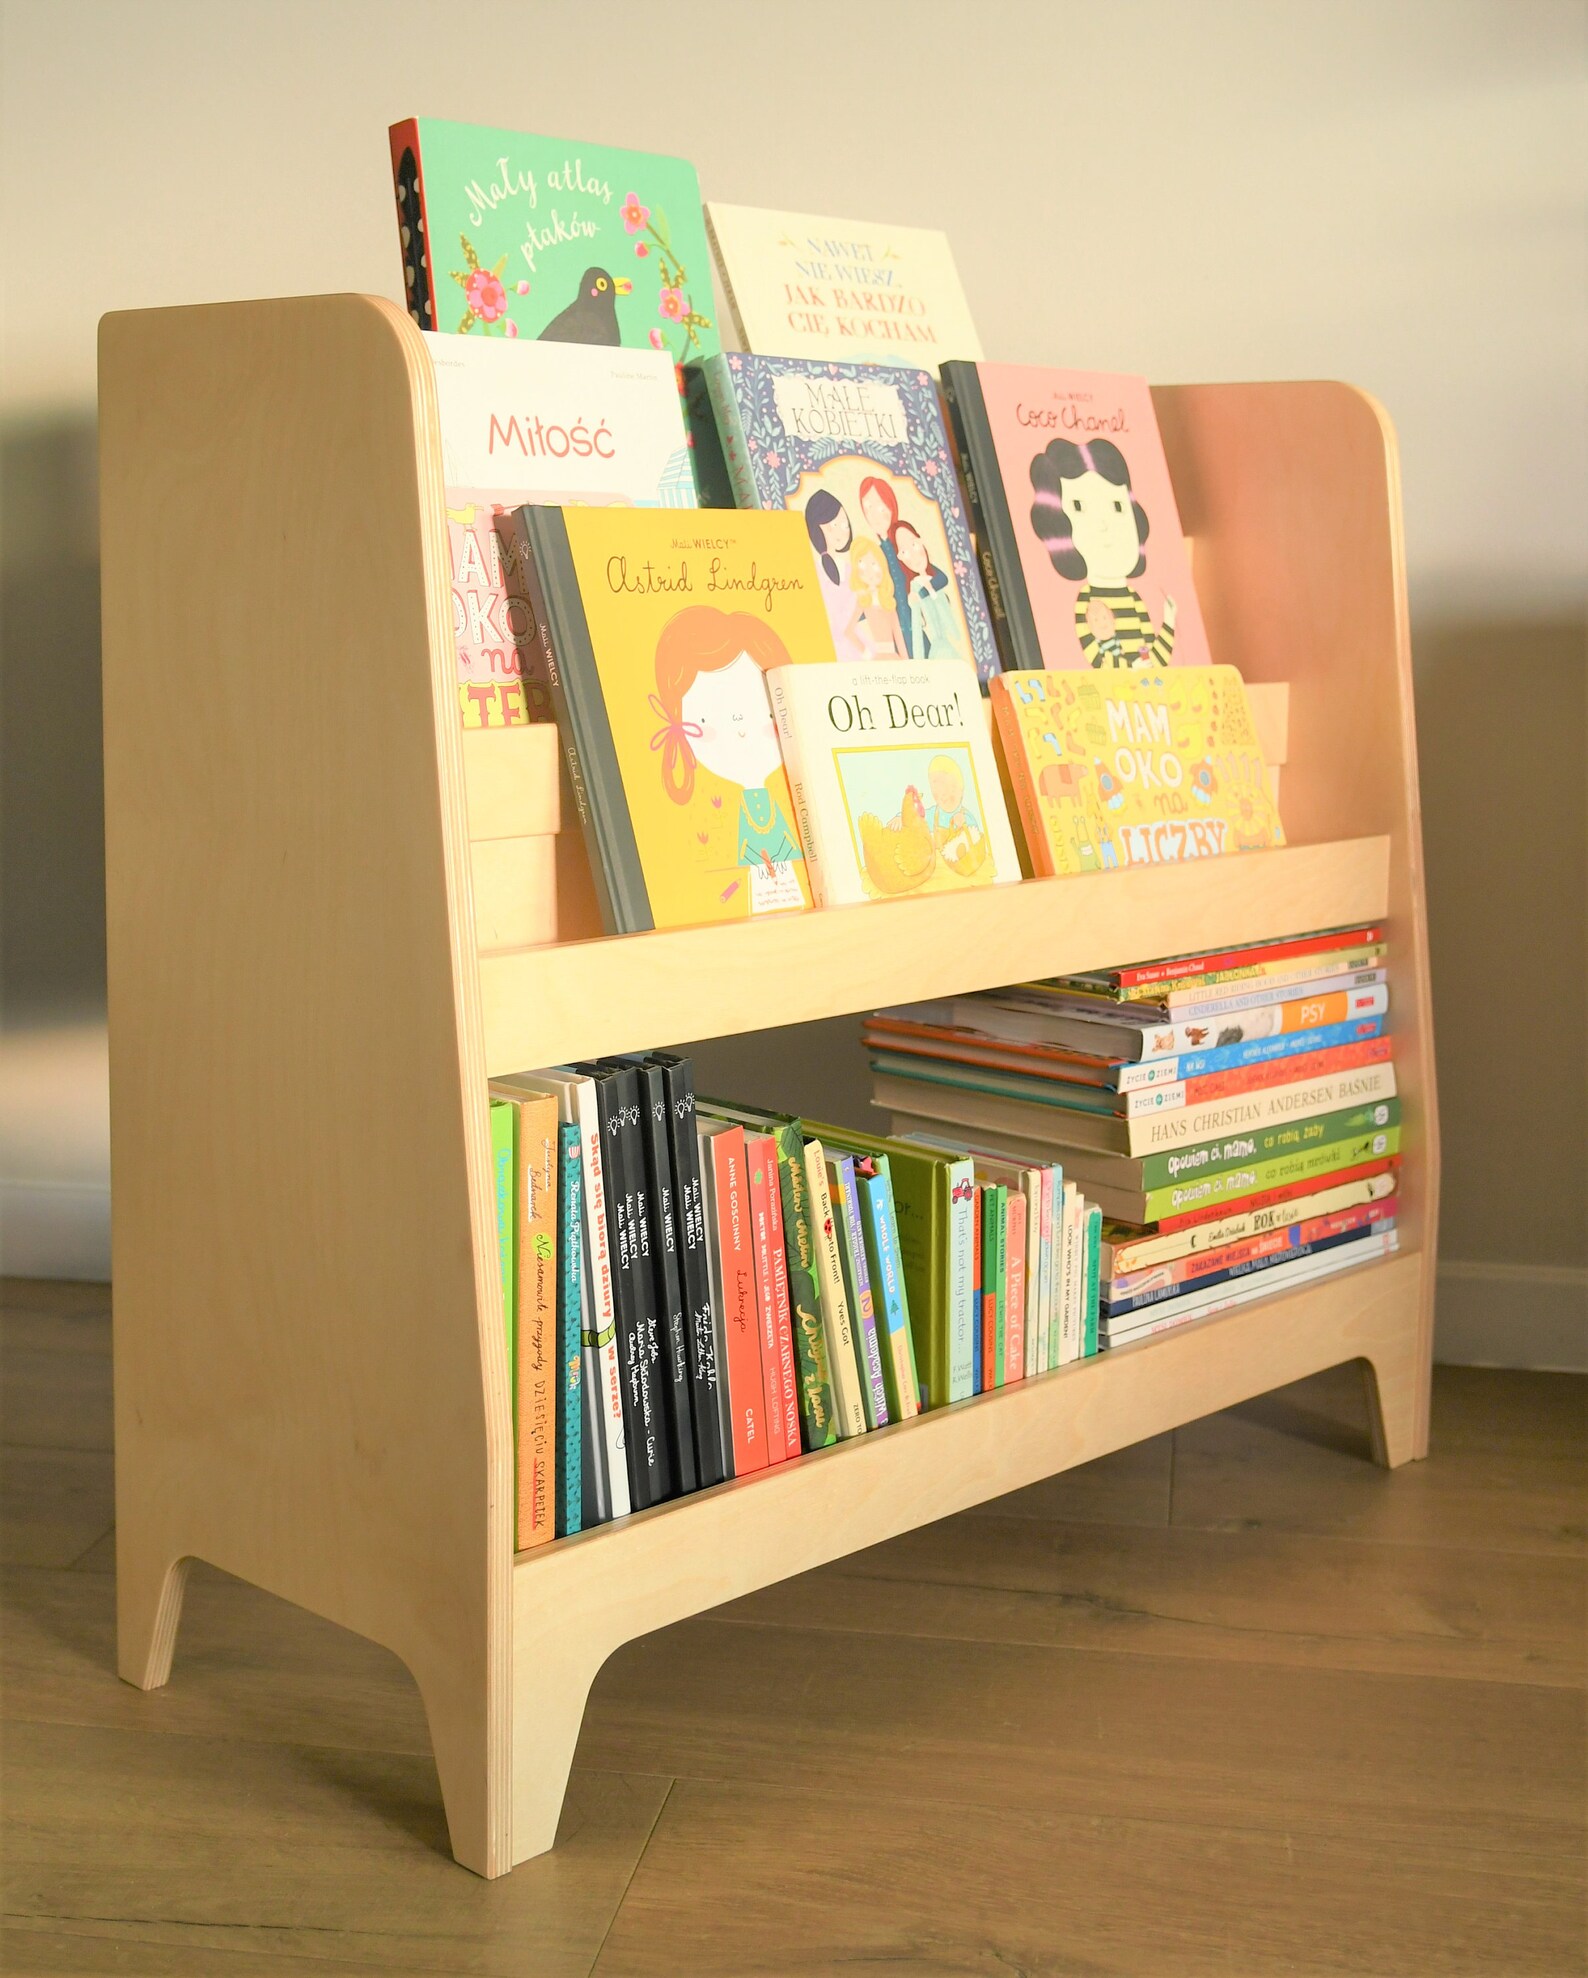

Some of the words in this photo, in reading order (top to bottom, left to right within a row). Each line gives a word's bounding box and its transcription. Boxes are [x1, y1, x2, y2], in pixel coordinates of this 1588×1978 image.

[464, 156, 538, 228] Mały
[547, 158, 614, 205] atlas
[519, 209, 602, 273] ptaków
[806, 238, 873, 262] NAWET
[795, 261, 832, 281] NIE
[784, 283, 826, 307] JAK
[832, 287, 927, 317] BARDZO
[787, 311, 830, 338] CIĘ
[835, 316, 938, 344] KOCHAM
[791, 407, 897, 439] KOBIETKI
[1015, 402, 1058, 429] Coco
[1061, 404, 1129, 432] Chanel
[488, 412, 616, 459] Miłość
[606, 555, 693, 594] Astrid
[706, 556, 804, 612] Lindgren
[545, 648, 560, 689] WIELCY
[909, 673, 931, 685] book
[773, 686, 785, 705] Oh
[827, 694, 877, 733] Oh
[882, 691, 965, 730] Dear!
[778, 707, 793, 740] Dear!
[1105, 698, 1172, 746] MAM
[1114, 746, 1183, 790] OKO
[794, 782, 807, 806] Rod
[1153, 792, 1189, 816] na
[800, 807, 819, 863] Campbell
[1119, 818, 1228, 866] LICZBY
[1300, 1002, 1327, 1025] PSY
[1151, 1119, 1188, 1143] HANS
[1193, 1102, 1261, 1133] CHRISTIAN
[1267, 1086, 1334, 1114] ANDERSEN
[1338, 1073, 1381, 1099] BAŚNIE
[590, 1132, 601, 1177] Skąd
[1264, 1137, 1274, 1148] co
[727, 1157, 737, 1188] ANNE
[813, 1149, 825, 1187] Louie's
[1265, 1169, 1276, 1179] co
[570, 1181, 581, 1219] Renata
[593, 1182, 603, 1212] się
[625, 1193, 634, 1218] Mali
[637, 1191, 645, 1216] Mali
[662, 1187, 670, 1213] Mali
[683, 1184, 692, 1209] Mali
[691, 1177, 700, 1201] Mali
[820, 1192, 831, 1218] Back
[616, 1203, 626, 1228] Mali
[663, 1212, 675, 1253] WIELCY
[685, 1208, 697, 1250] WIELCY
[693, 1200, 704, 1242] WIELCY
[730, 1190, 742, 1252] GOSCINNY
[958, 1207, 969, 1247] That's
[1254, 1210, 1276, 1232] ROK
[569, 1221, 581, 1284] Piątkowska
[594, 1213, 607, 1262] biorą
[619, 1227, 630, 1270] WIELCY
[628, 1218, 639, 1259] WIELCY
[638, 1216, 650, 1257] WIELCY
[828, 1242, 836, 1253] to
[879, 1215, 890, 1252] WHOLE
[885, 1254, 896, 1294] WORLD
[829, 1253, 841, 1284] Front!
[958, 1249, 968, 1271] not
[1011, 1256, 1022, 1268] A
[600, 1264, 613, 1318] dziury
[734, 1269, 749, 1334] Lukrecja
[955, 1271, 965, 1298] my
[1010, 1274, 1022, 1310] Piece
[1065, 1289, 1071, 1302] MY
[837, 1300, 847, 1326] Yves
[1010, 1315, 1021, 1331] of
[606, 1345, 616, 1361] w
[840, 1326, 851, 1347] Got
[866, 1326, 884, 1380] Academia
[1009, 1334, 1021, 1371] Cake
[777, 1326, 795, 1399] CZARNEGO
[608, 1365, 622, 1419] serze?
[636, 1321, 645, 1359] Maria
[646, 1436, 656, 1467] Curie
[744, 1407, 757, 1444] CATEL
[784, 1400, 798, 1447] NOSKA
